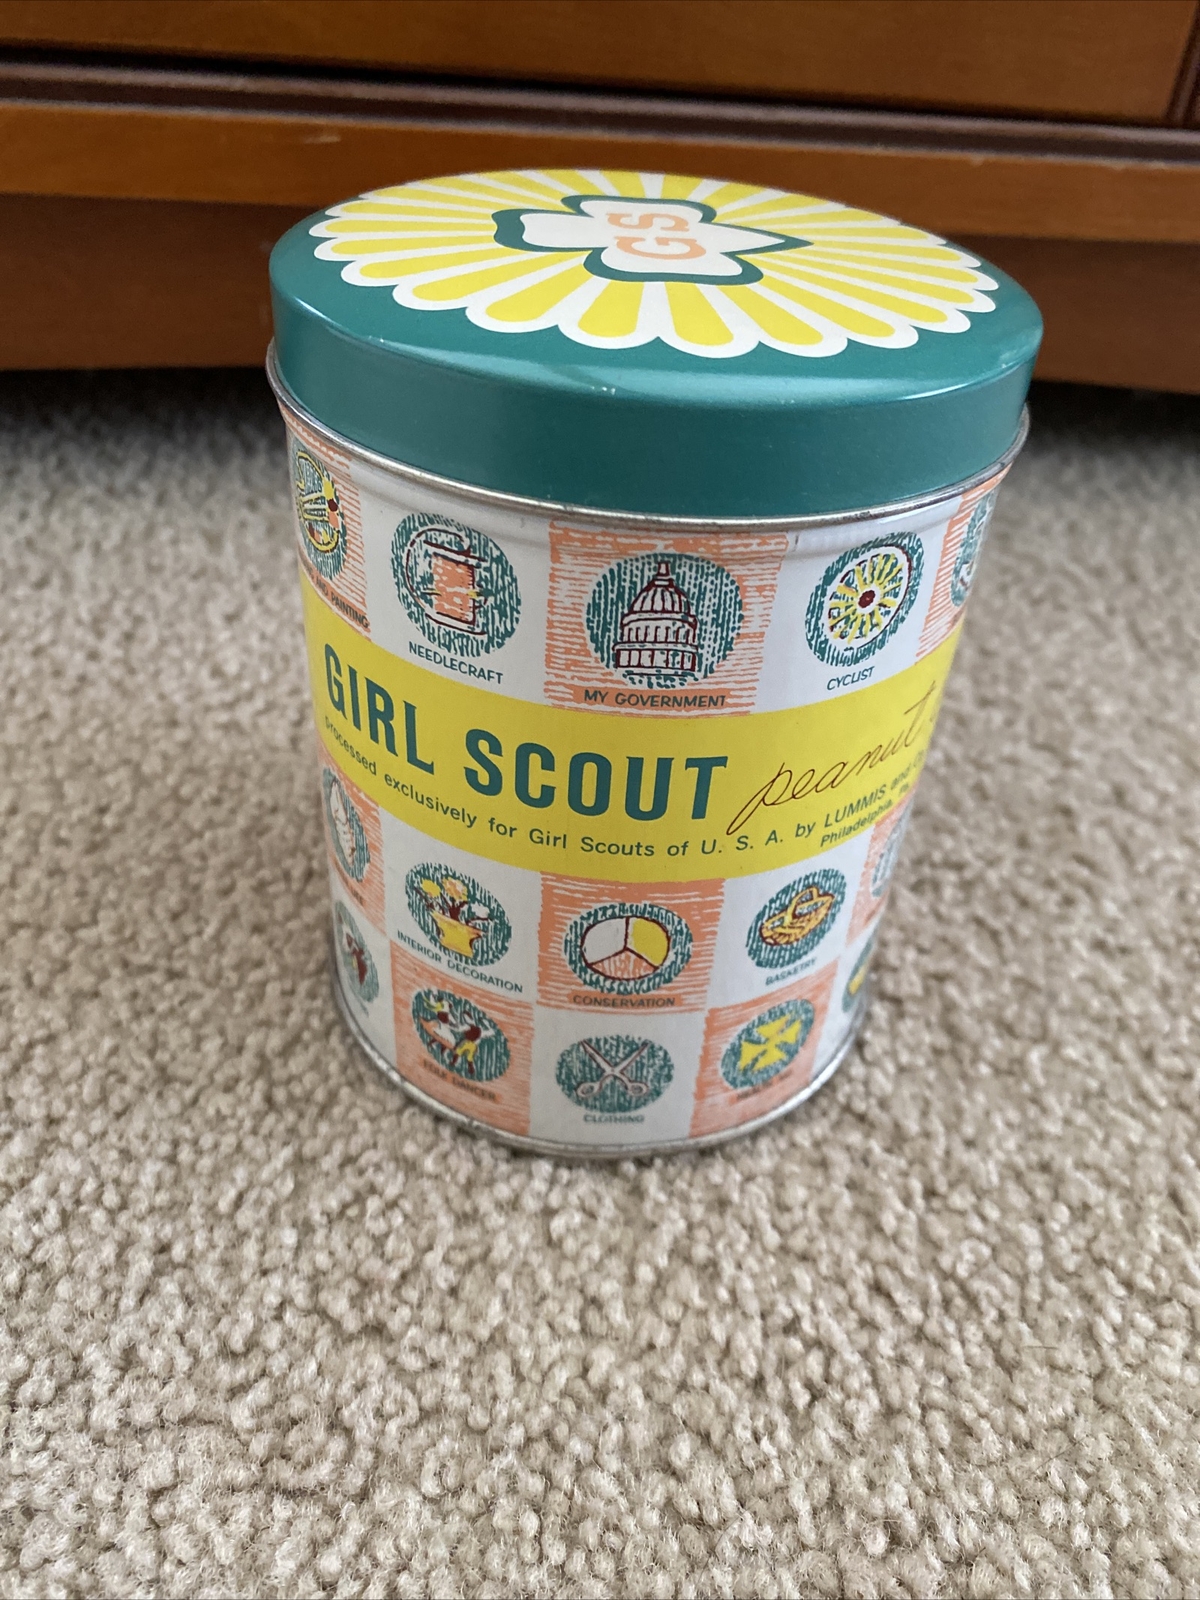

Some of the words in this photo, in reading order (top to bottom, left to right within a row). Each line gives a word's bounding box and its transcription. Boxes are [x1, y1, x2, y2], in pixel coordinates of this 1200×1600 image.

[330, 591, 370, 629] PAINTING
[408, 641, 504, 685] NEEDLECRAFT
[826, 666, 875, 691] CYCLIST
[584, 690, 608, 703] MY
[615, 692, 727, 708] GOVERNMENT
[324, 643, 435, 776] GIRL
[463, 728, 728, 822] SCOUT
[325, 716, 377, 776] processed
[384, 773, 477, 828] exclusively
[488, 817, 518, 839] for
[529, 828, 567, 850] Girl
[581, 836, 655, 858] Scouts
[667, 840, 689, 857] of
[701, 839, 723, 856] U.
[735, 835, 754, 851] S.
[764, 829, 784, 847] A.
[794, 821, 817, 839] by
[824, 783, 887, 828] LUMMIS
[397, 930, 442, 963] INTERIOR
[447, 958, 524, 994] DECORATION
[765, 957, 817, 987] BASKETRY
[573, 995, 676, 1008] CONSERVATION
[452, 1077, 497, 1100] DANCER
[583, 1114, 645, 1124] CLOTHING
